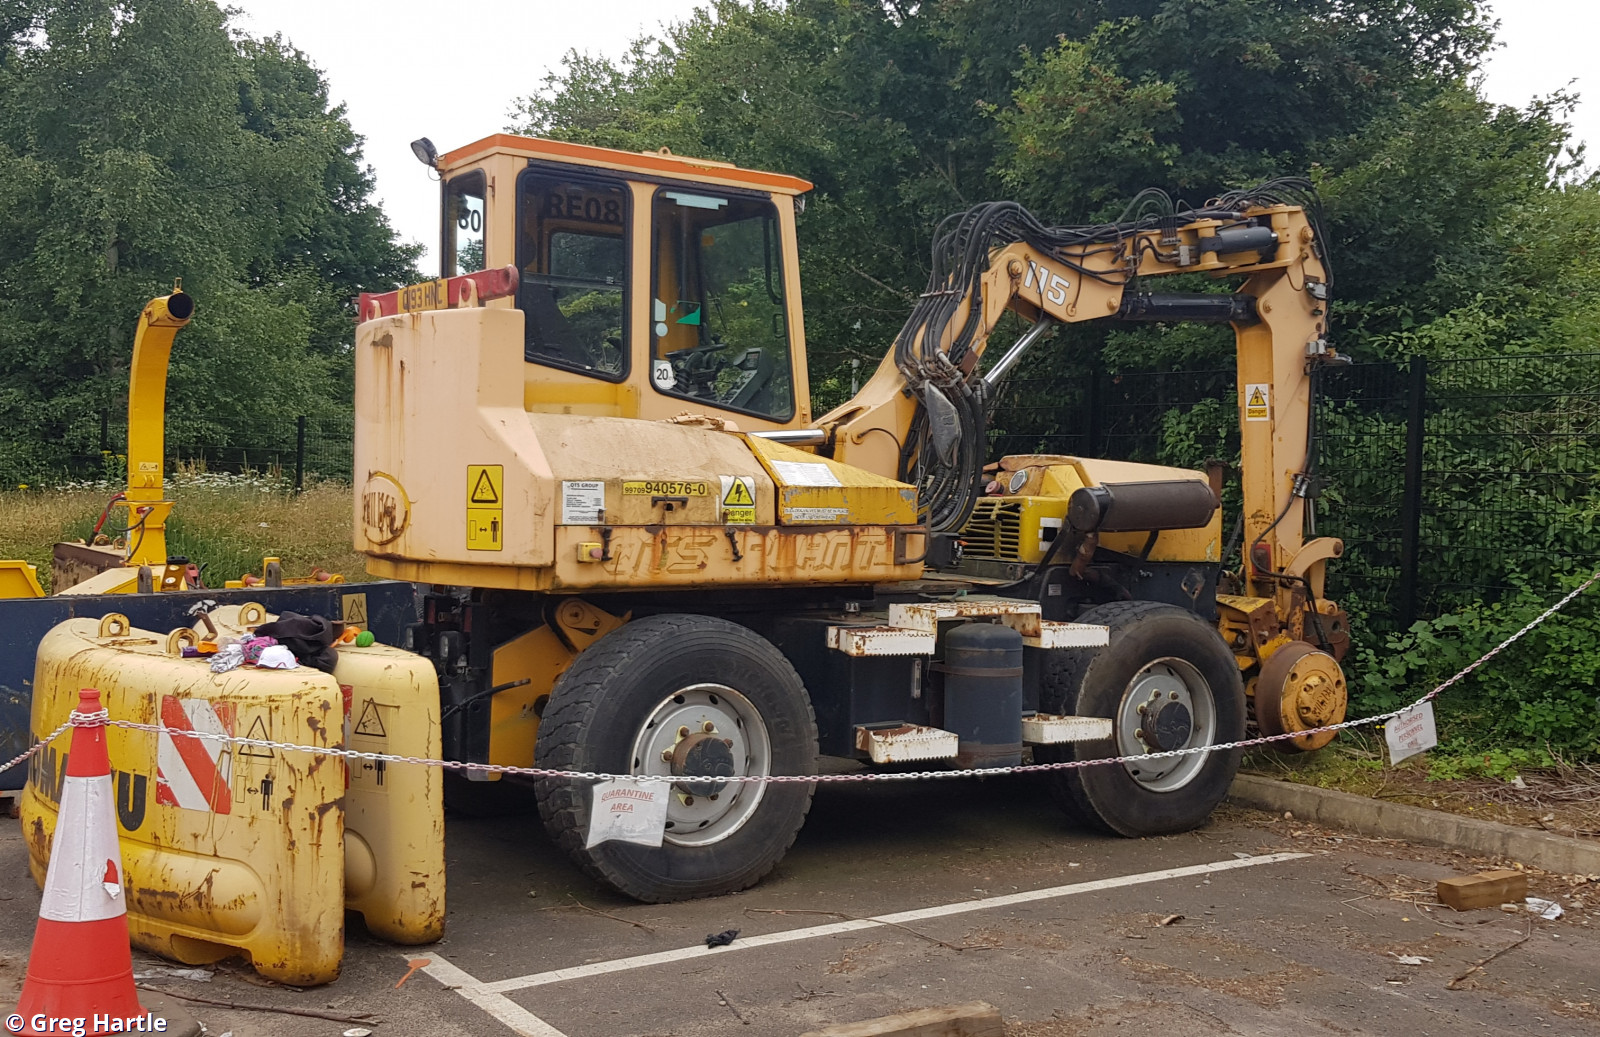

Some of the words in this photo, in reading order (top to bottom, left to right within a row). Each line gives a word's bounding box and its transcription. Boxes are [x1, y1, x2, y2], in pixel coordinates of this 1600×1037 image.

[1024, 260, 1070, 306] 115
[656, 368, 669, 380] 20
[645, 482, 706, 494] 940576-0
[601, 789, 654, 801] QUARANTINE
[611, 803, 634, 811] AREA
